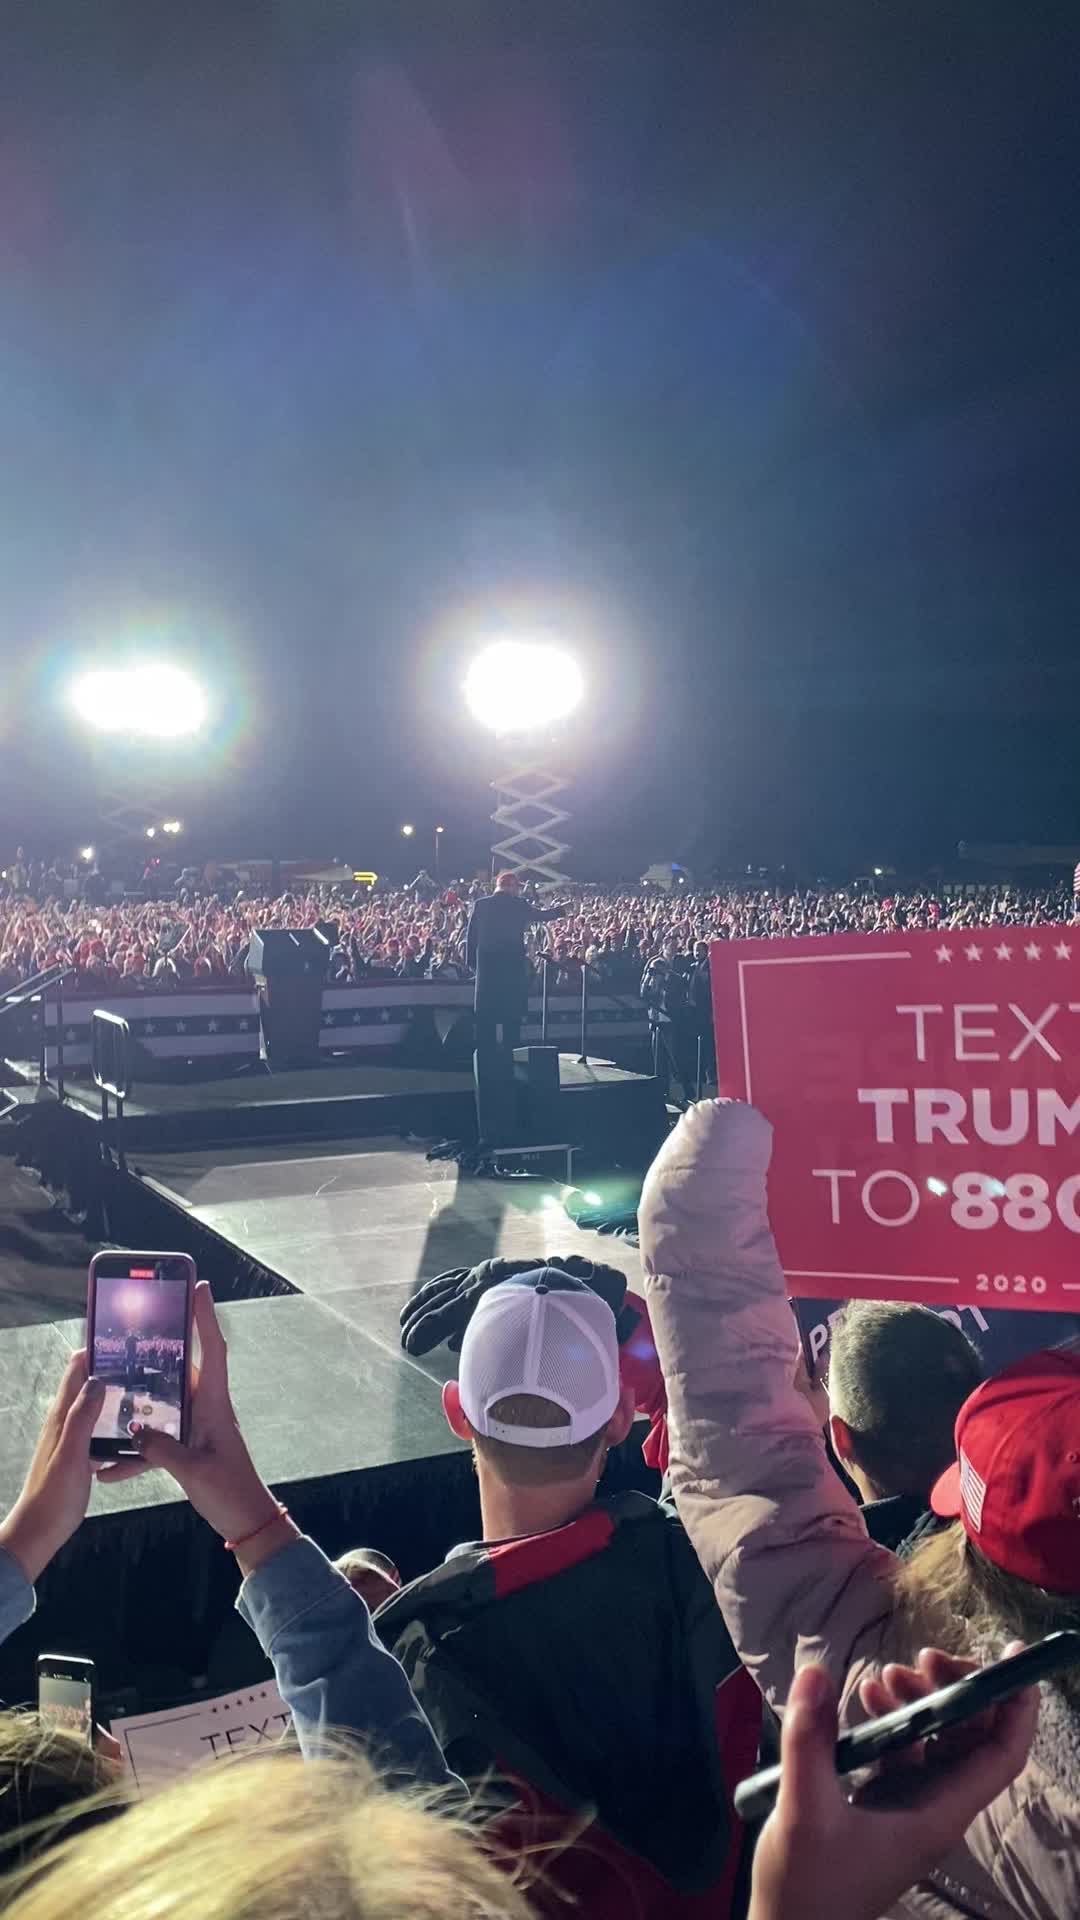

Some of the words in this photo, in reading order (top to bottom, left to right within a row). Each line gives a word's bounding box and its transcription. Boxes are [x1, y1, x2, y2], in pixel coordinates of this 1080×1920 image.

[896, 1003, 1080, 1062] TEX
[811, 1168, 920, 1227] TO
[975, 1273, 1047, 1294] 2020
